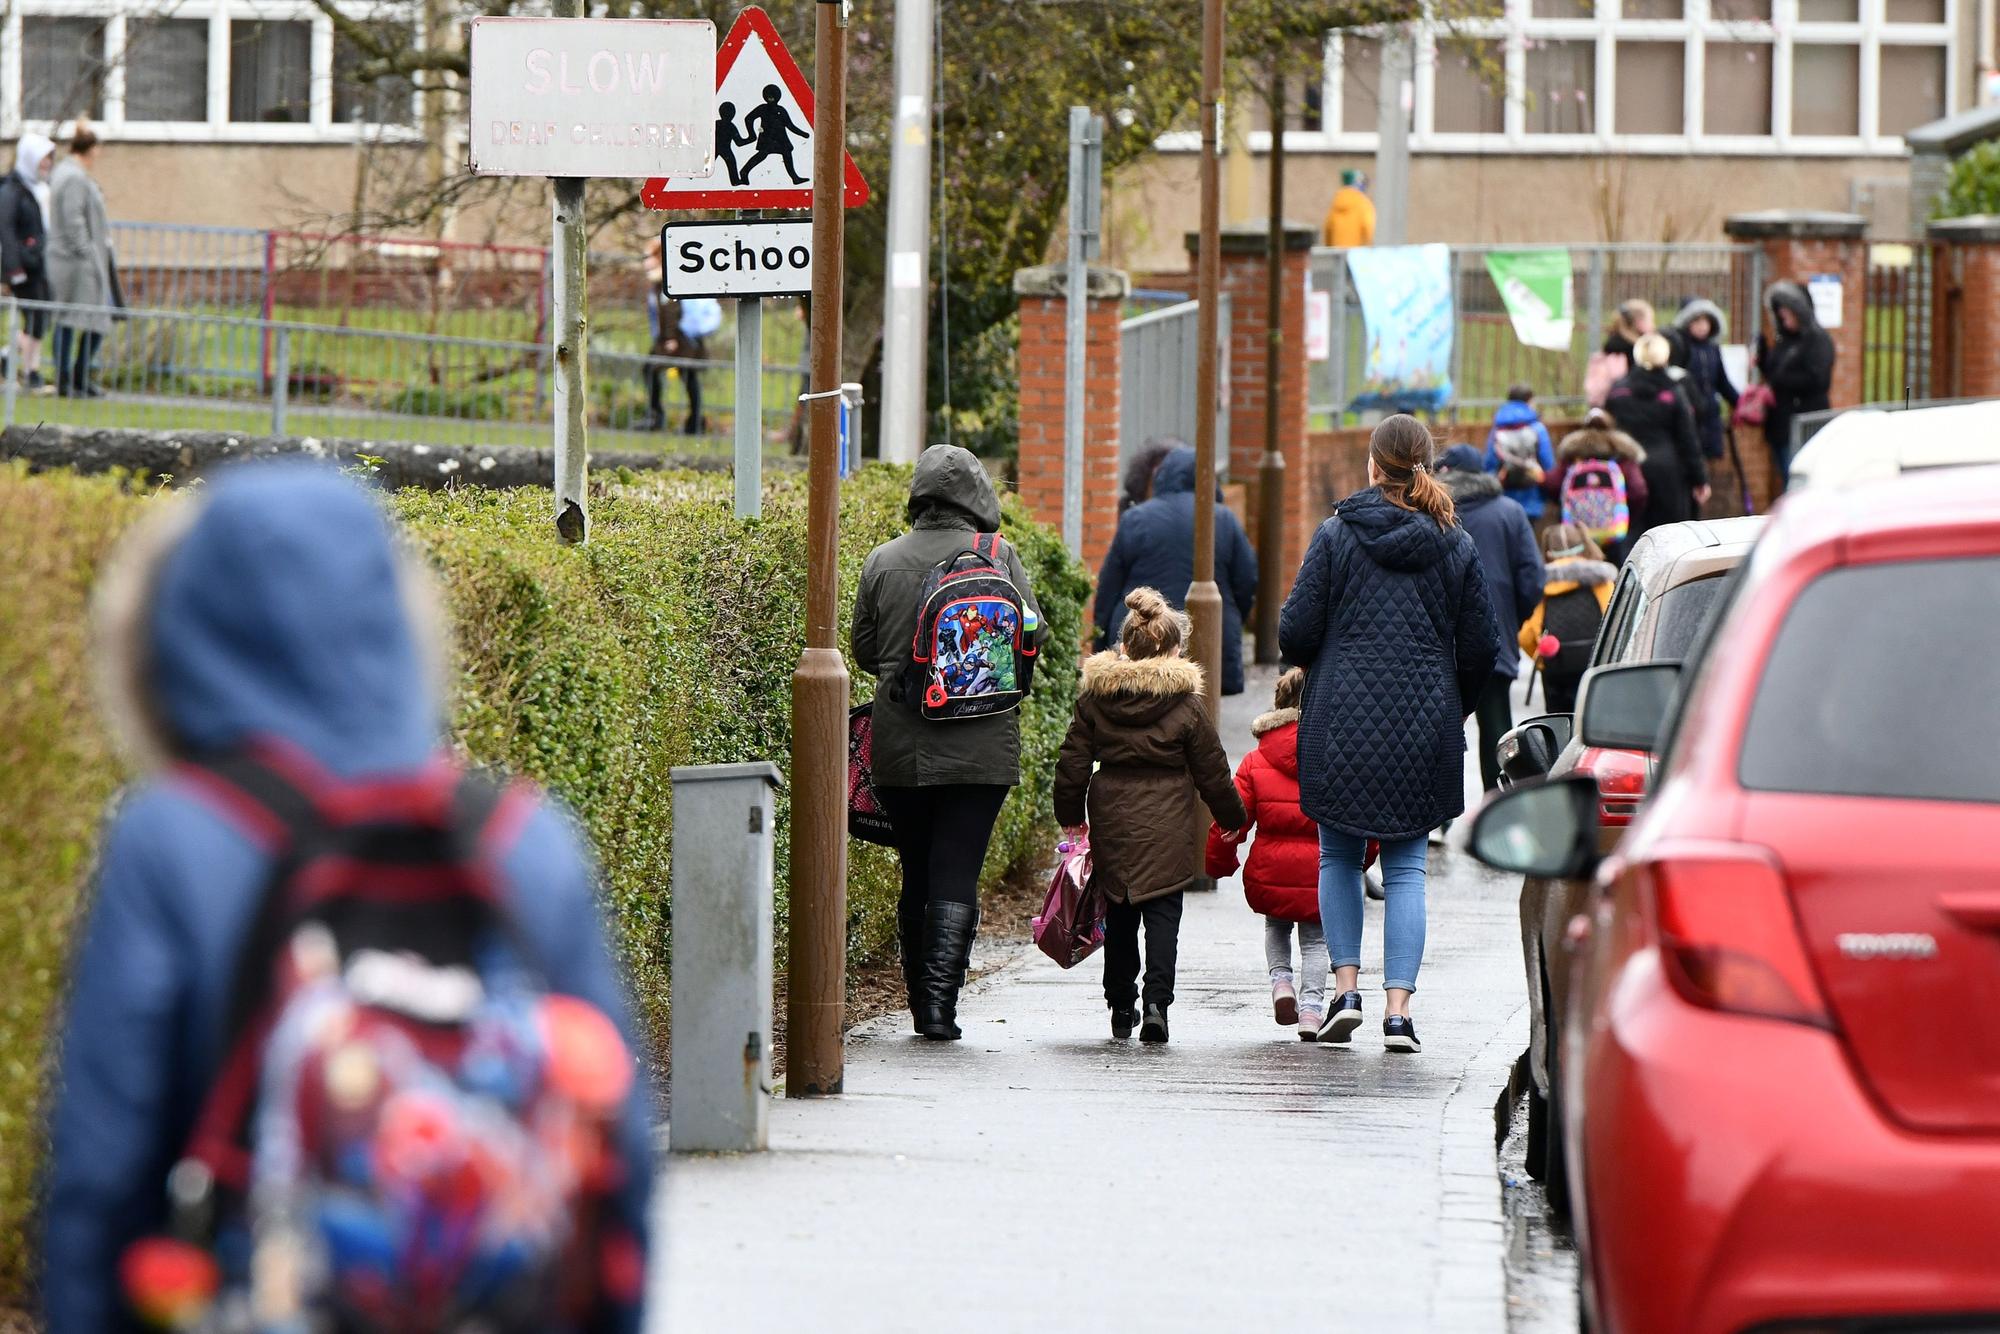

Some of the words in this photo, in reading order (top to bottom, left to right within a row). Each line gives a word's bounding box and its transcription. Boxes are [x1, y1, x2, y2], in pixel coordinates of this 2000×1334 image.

[524, 48, 670, 96] SLOW
[491, 120, 557, 146] DEAF
[570, 122, 696, 148] CHILDREN
[679, 240, 810, 274] Schoo
